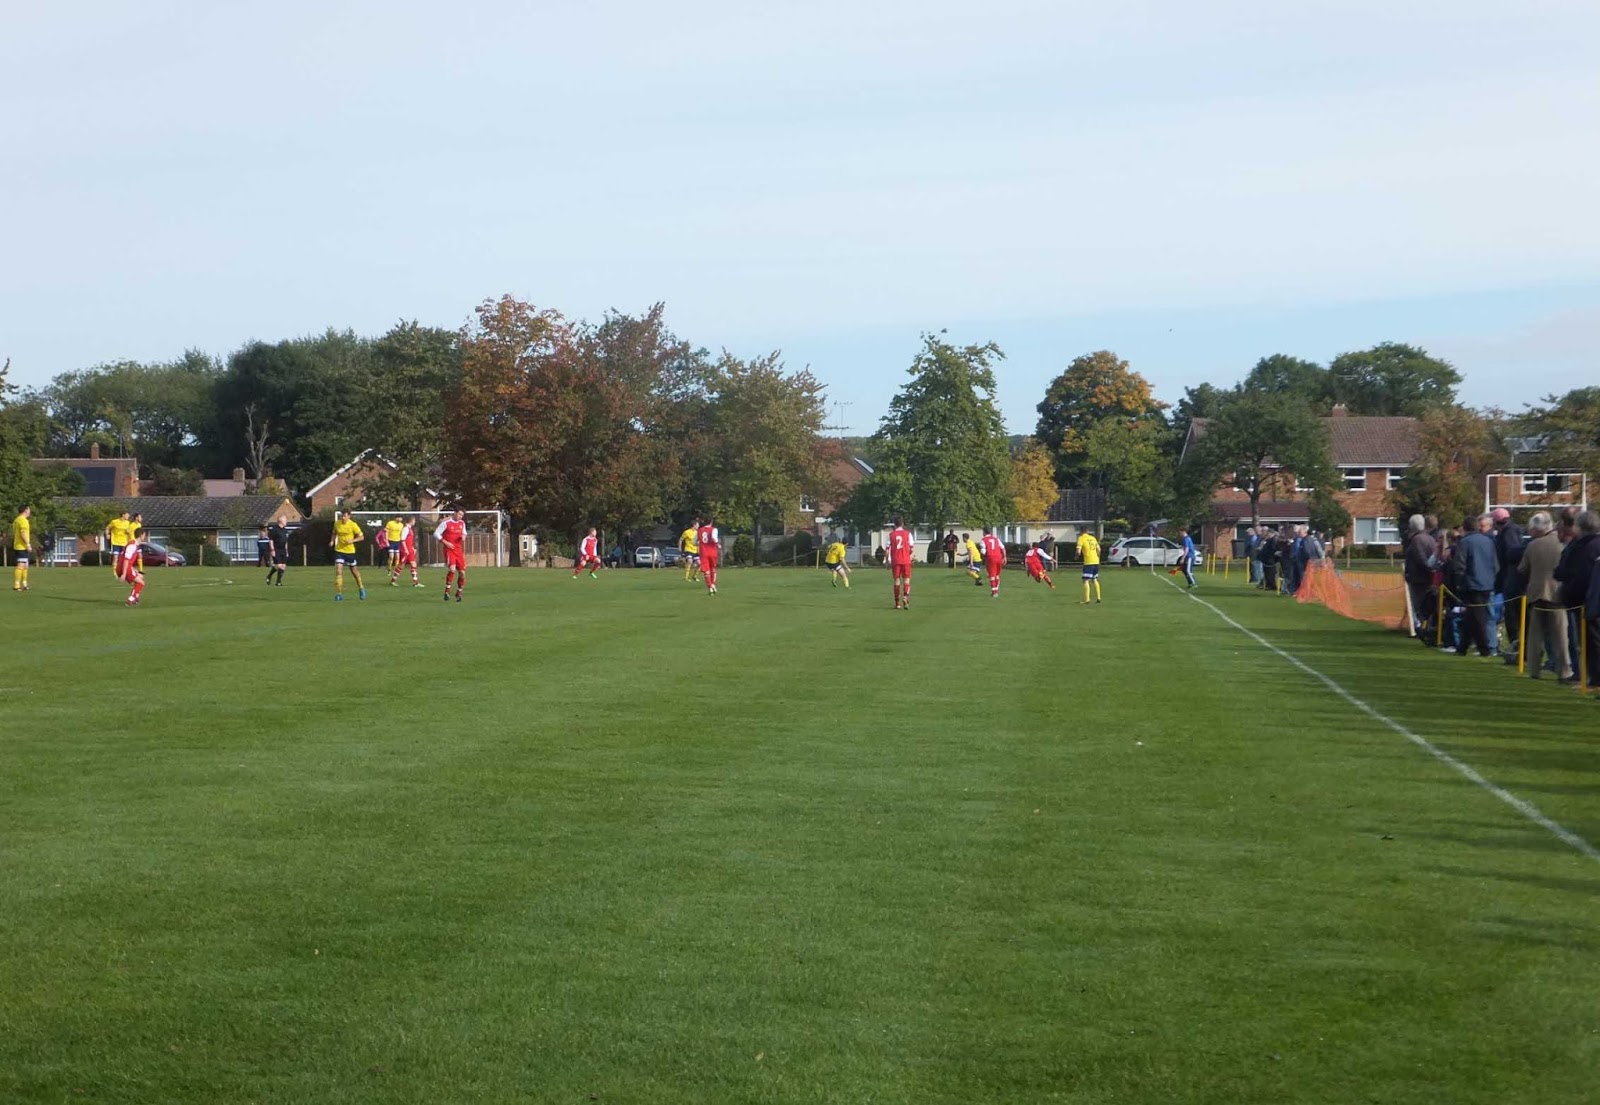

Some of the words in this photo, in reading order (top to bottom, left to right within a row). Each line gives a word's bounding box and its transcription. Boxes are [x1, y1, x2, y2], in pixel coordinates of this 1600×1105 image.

[702, 532, 708, 543] 8
[896, 536, 903, 549] 2
[988, 539, 995, 550] 7
